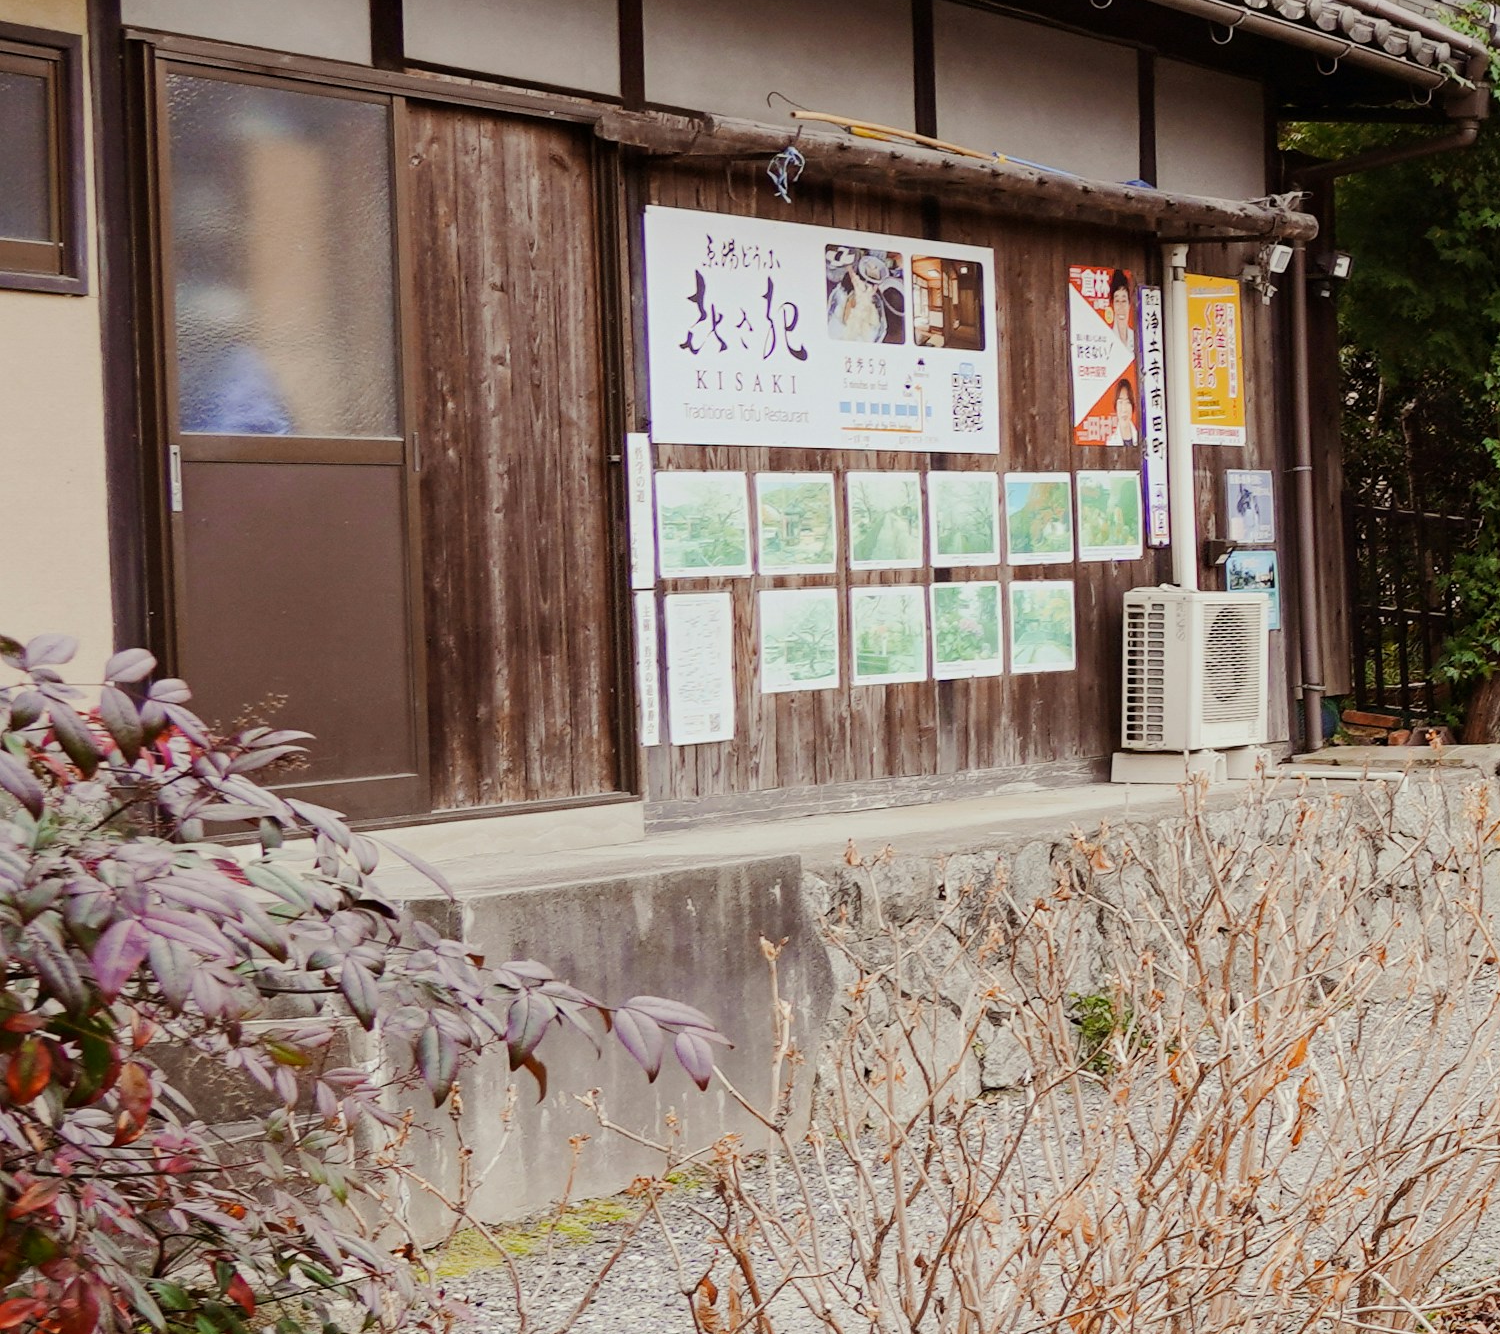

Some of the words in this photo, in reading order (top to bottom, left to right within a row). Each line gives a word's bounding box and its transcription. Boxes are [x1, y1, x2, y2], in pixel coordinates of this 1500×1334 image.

[1204, 303, 1216, 387] くらしの
[696, 369, 797, 394] KISAKI
[683, 403, 735, 420] Traditional
[737, 404, 761, 422] Tofu
[763, 406, 809, 423] Restaurant
